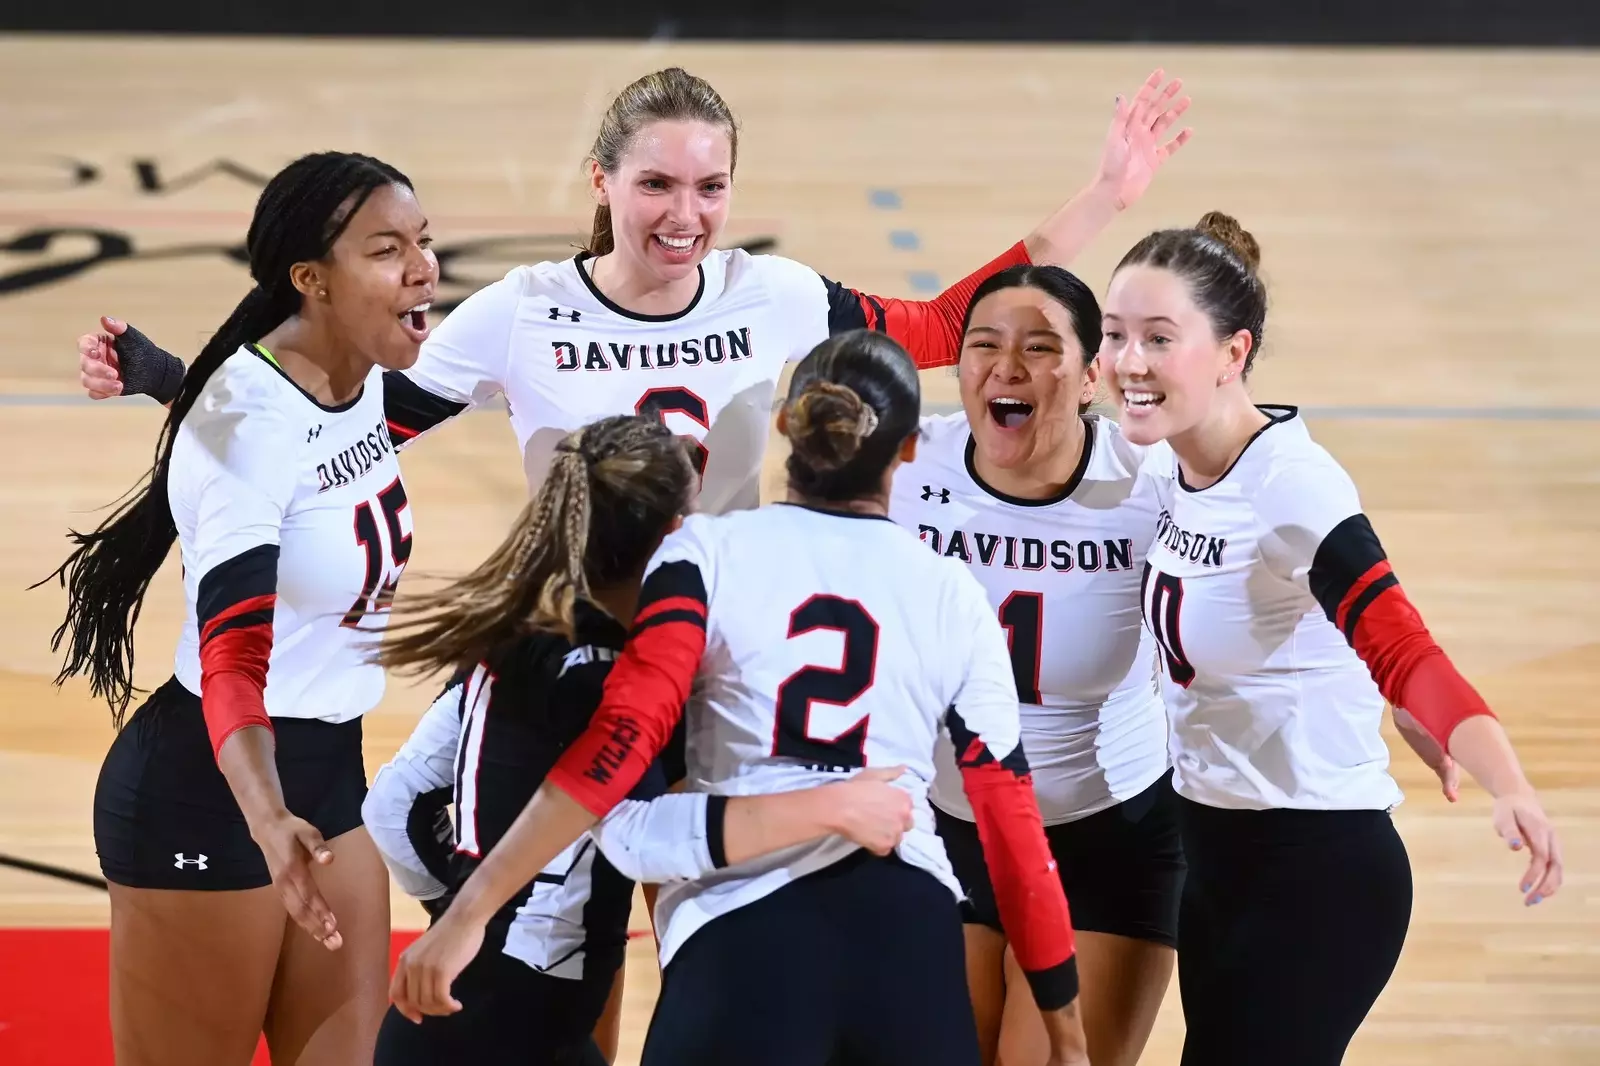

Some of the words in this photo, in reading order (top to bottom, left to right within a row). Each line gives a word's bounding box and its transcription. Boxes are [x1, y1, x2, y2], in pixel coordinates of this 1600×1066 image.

[551, 327, 752, 371] DAVIDSON
[316, 413, 391, 494] DAVIDSO
[338, 474, 413, 628] 15
[918, 524, 1133, 573] DAVIDSON
[771, 593, 880, 768] 2
[998, 590, 1043, 705] 1
